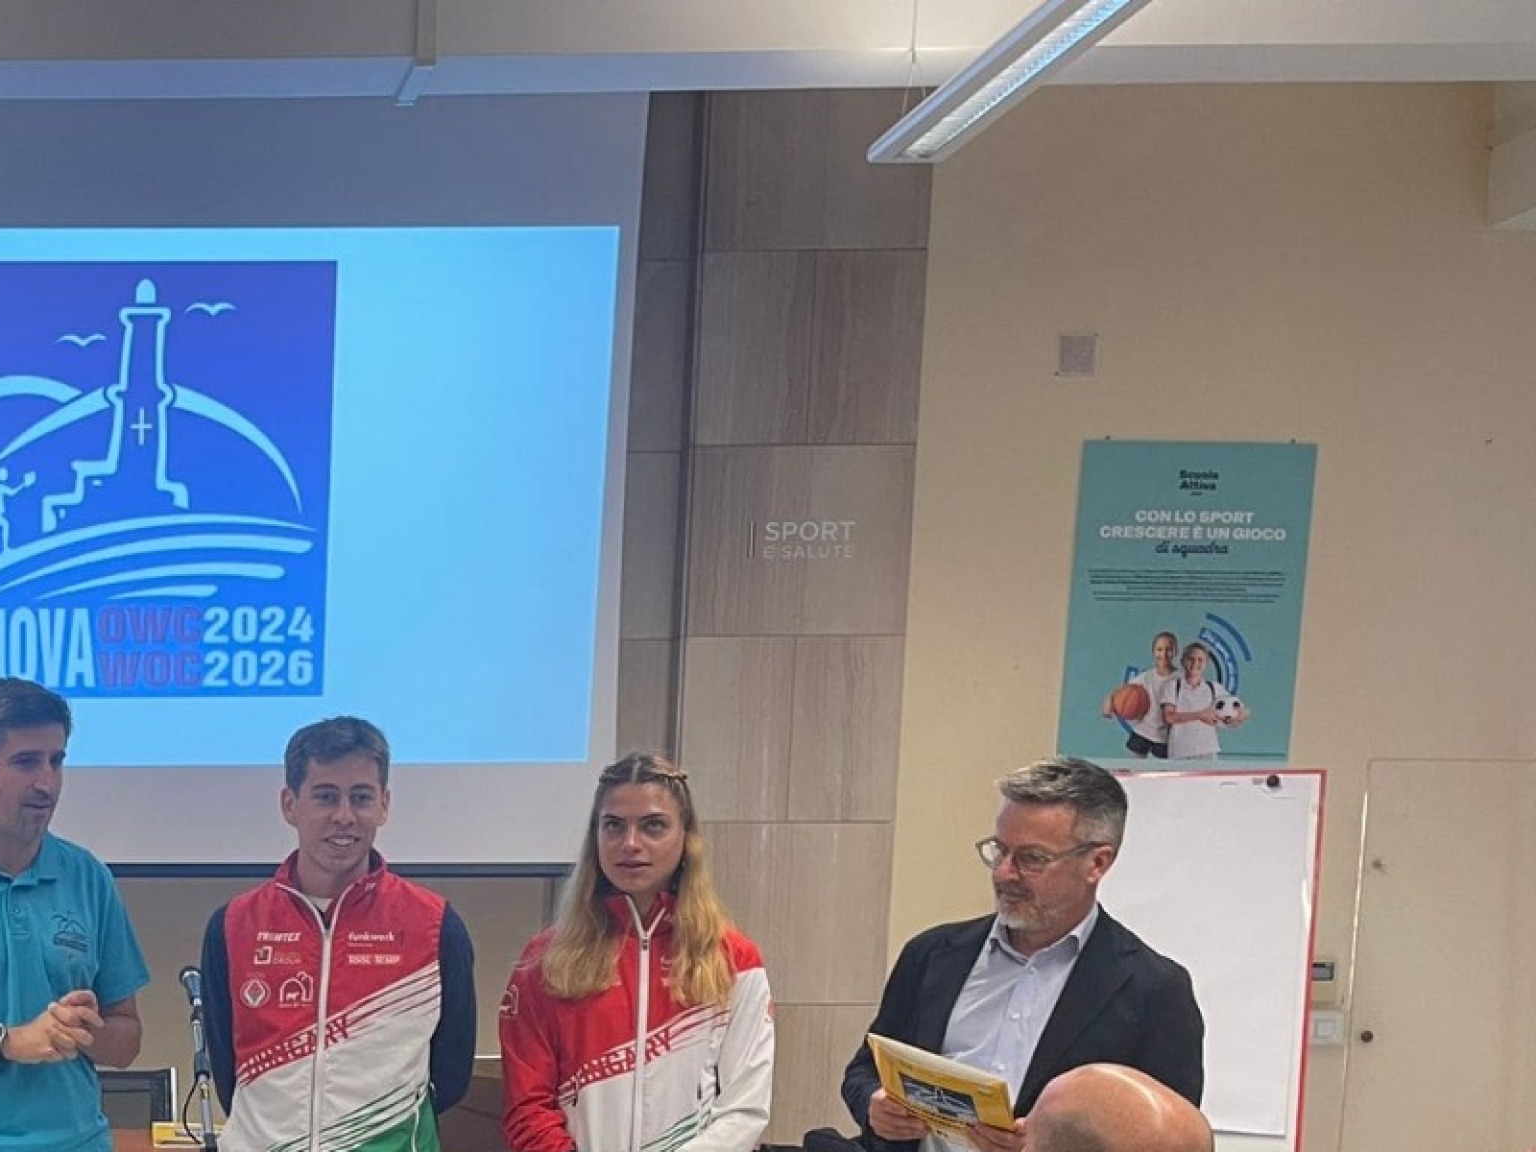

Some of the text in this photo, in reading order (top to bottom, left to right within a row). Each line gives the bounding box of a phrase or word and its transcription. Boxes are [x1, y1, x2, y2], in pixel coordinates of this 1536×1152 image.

[1135, 510, 1255, 524] CON LO SPORT
[765, 521, 856, 541] SPORT
[1099, 526, 1191, 539] CRESCERE
[1207, 527, 1230, 540] UN
[1233, 527, 1287, 541] GIOCO
[764, 545, 854, 560] E SALUTE
[1172, 541, 1229, 559] squadra
[99, 606, 314, 644] OWC 2024
[99, 650, 314, 687] WOC 2026
